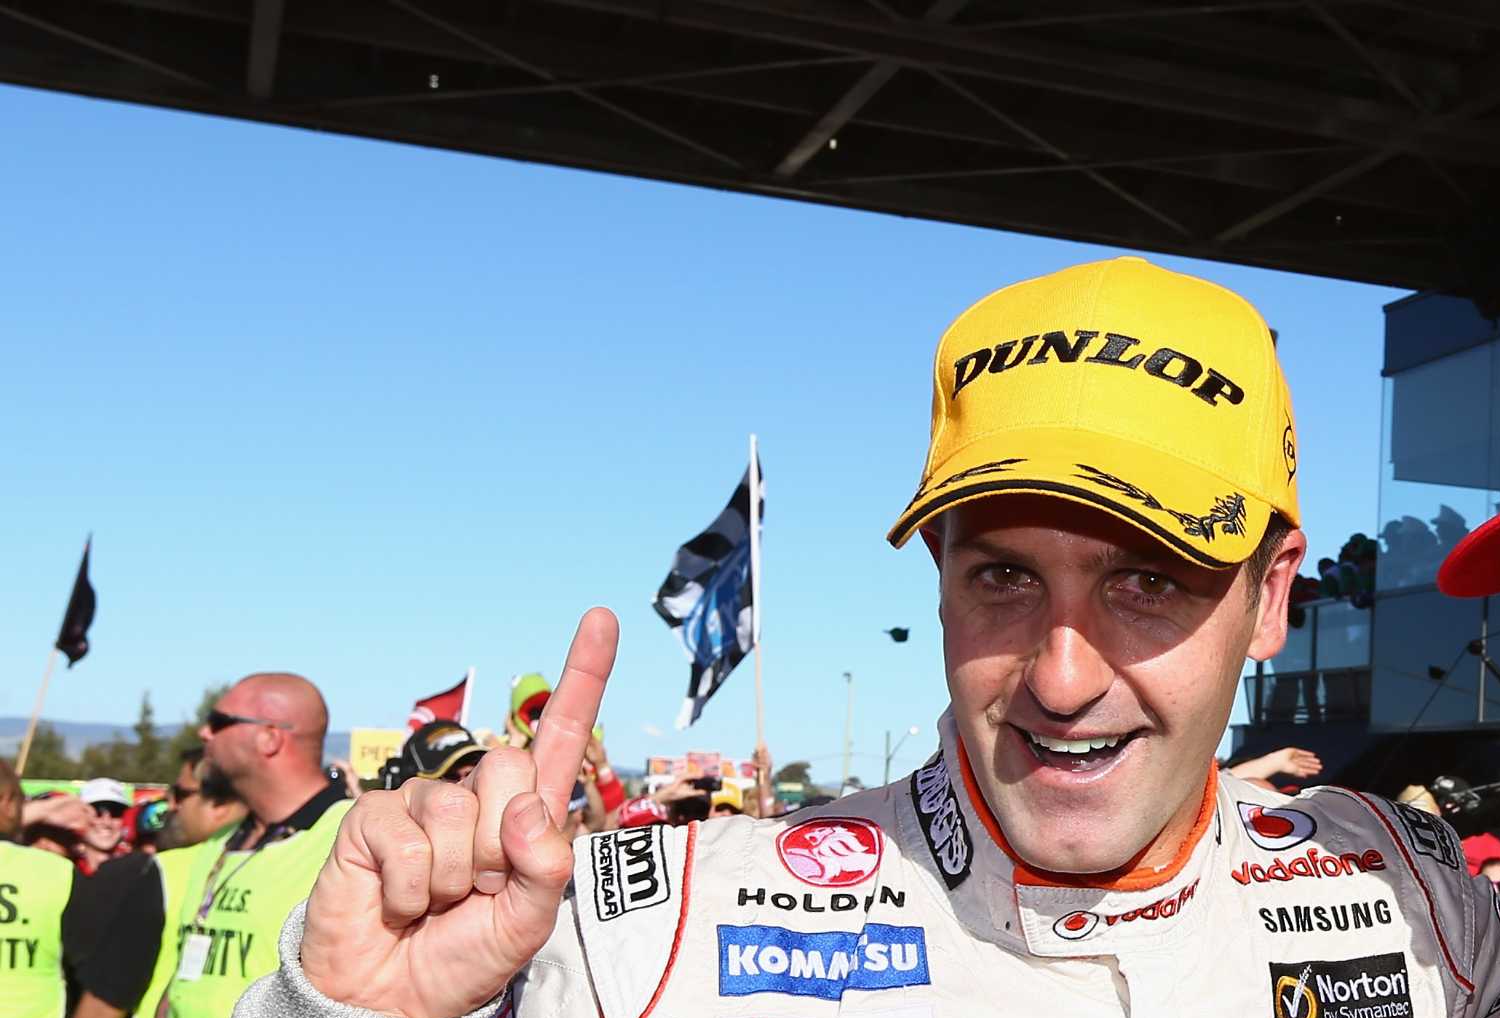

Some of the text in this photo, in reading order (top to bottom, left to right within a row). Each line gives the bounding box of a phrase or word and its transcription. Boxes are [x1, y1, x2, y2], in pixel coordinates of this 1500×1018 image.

[952, 329, 1246, 407] DUNLOP
[1230, 847, 1387, 887] vodafone
[1258, 898, 1393, 933] SAMSUNG
[1315, 970, 1408, 1004] Norton
